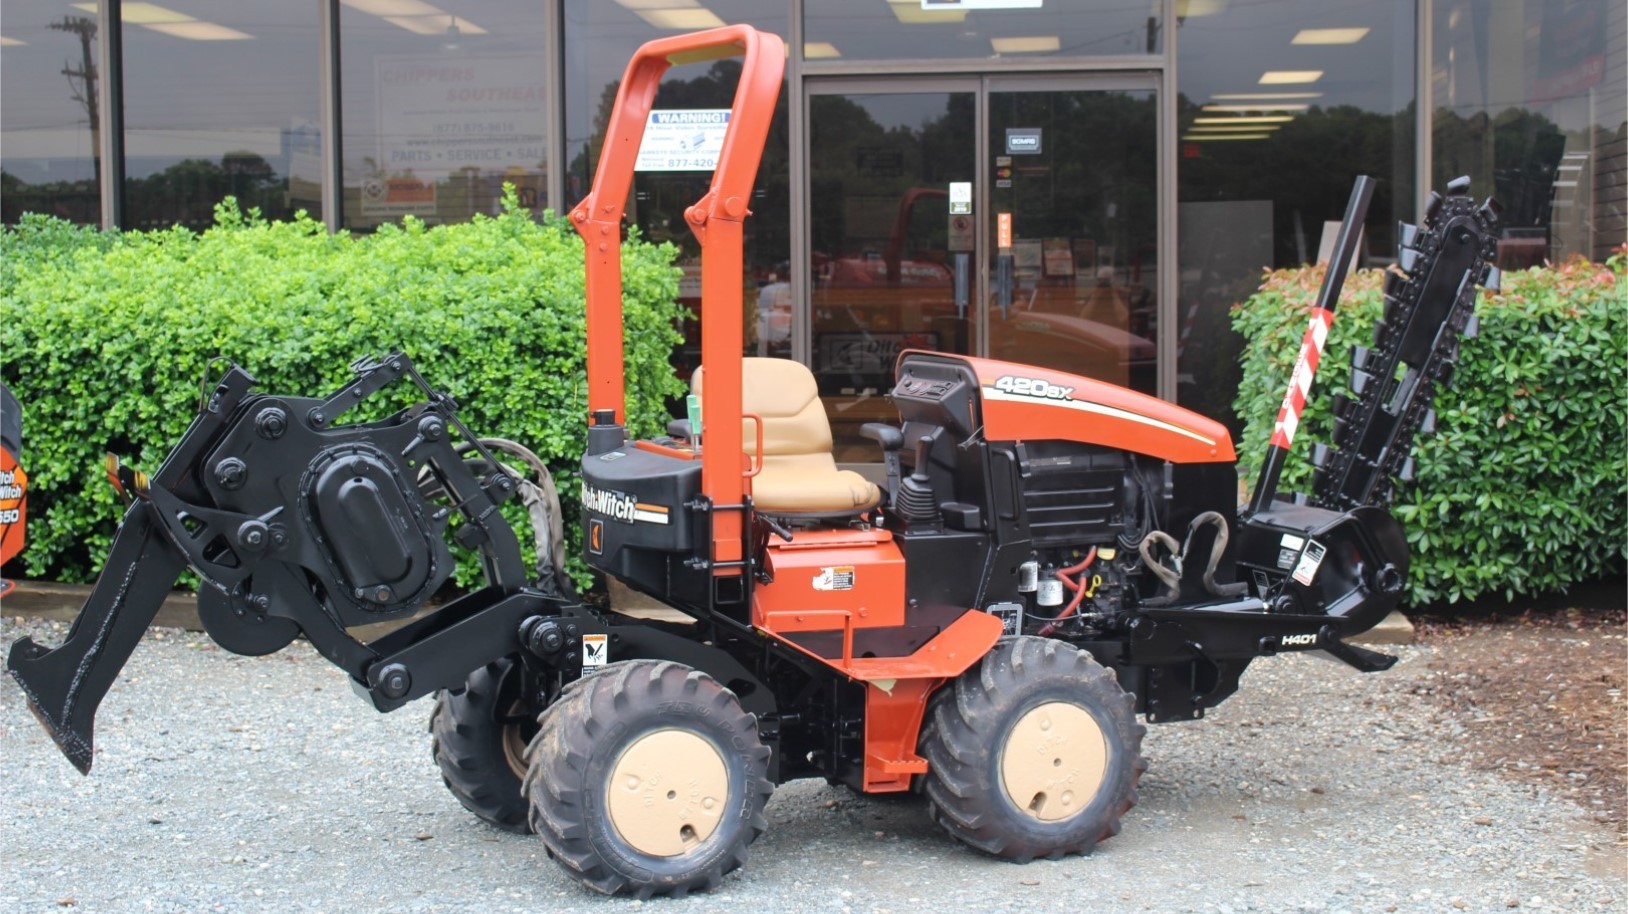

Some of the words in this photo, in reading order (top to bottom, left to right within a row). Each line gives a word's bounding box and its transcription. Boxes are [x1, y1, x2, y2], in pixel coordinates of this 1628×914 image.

[383, 67, 476, 84] CHIPPERS
[657, 112, 726, 123] WARNING!
[391, 149, 433, 162] PARTS
[447, 148, 502, 161] SERVICE
[1001, 213, 1009, 247] PULL
[1281, 633, 1318, 646] H401
